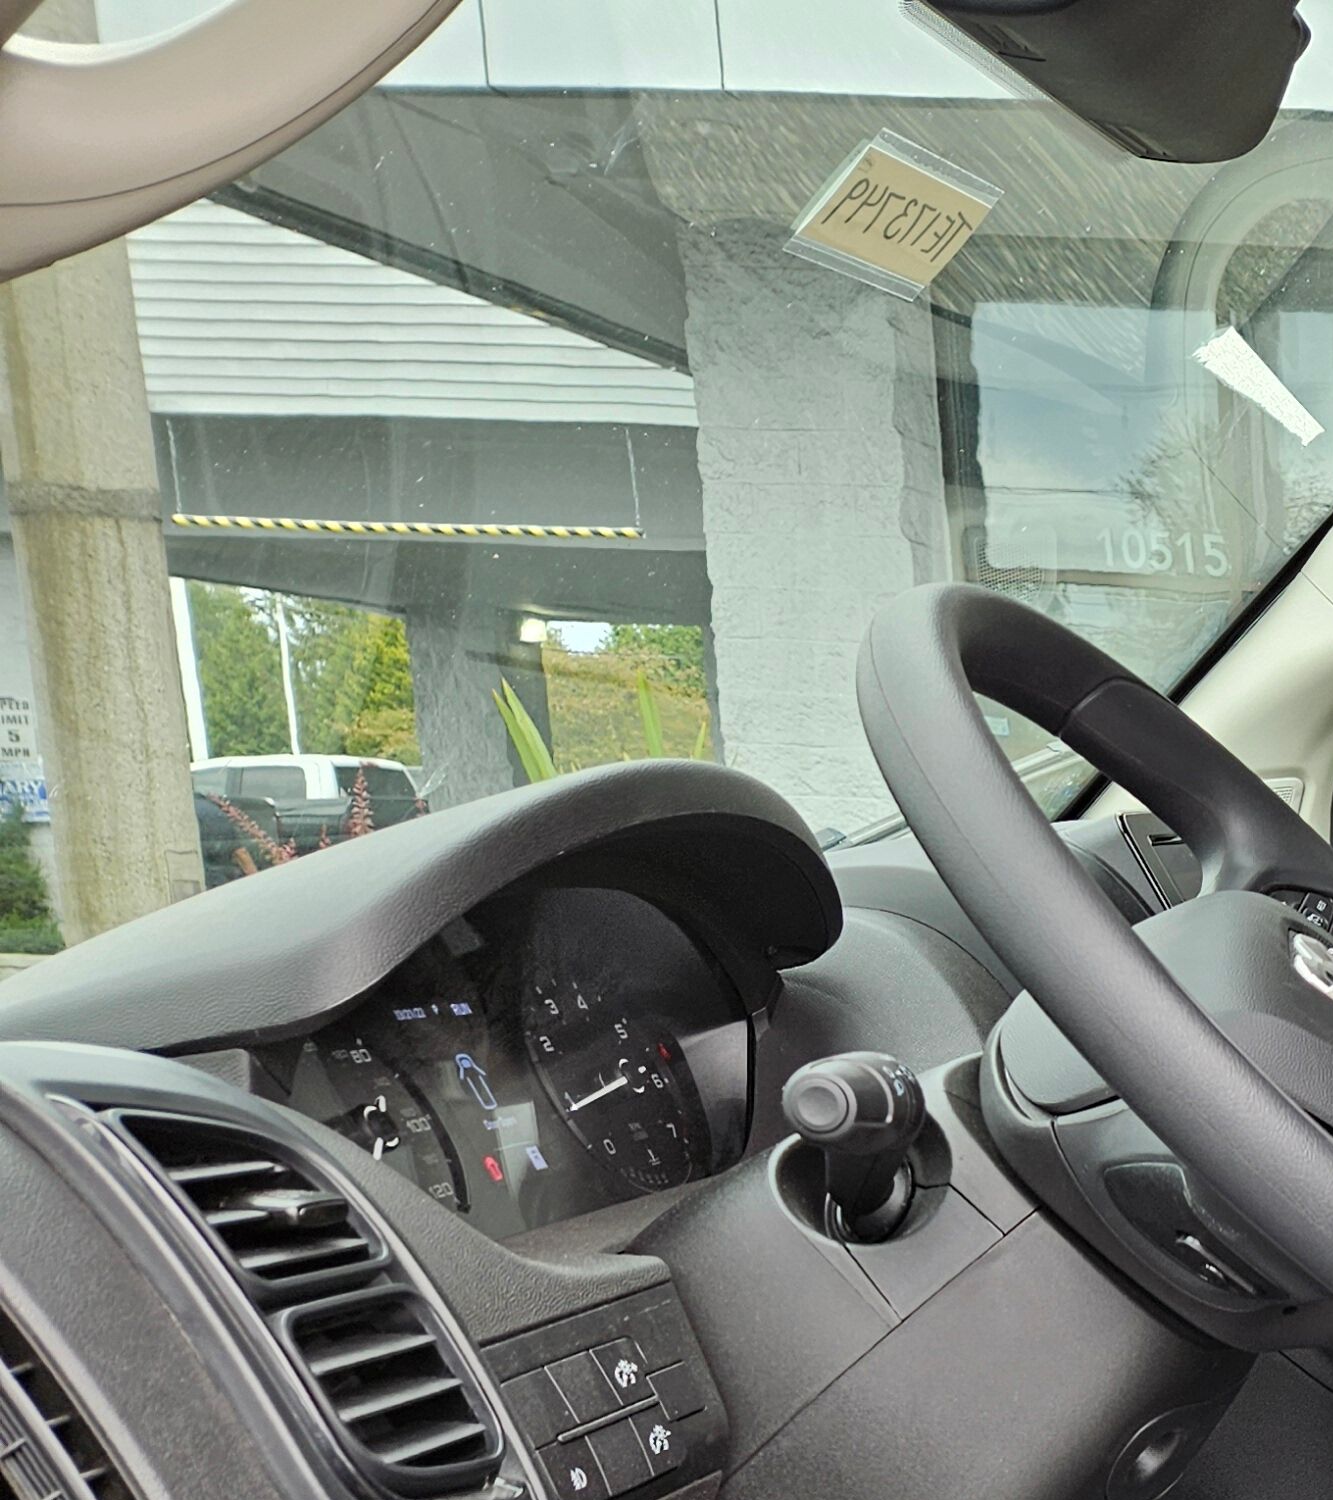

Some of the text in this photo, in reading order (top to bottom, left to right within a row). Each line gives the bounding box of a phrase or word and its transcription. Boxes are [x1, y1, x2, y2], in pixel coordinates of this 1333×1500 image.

[1096, 527, 1229, 577] 10515
[544, 999, 560, 1016] 3
[614, 1023, 629, 1040] 5
[539, 1035, 555, 1053] 2
[350, 1048, 372, 1064] 80
[651, 1073, 664, 1089] 6
[406, 1119, 431, 1133] 100
[602, 1138, 618, 1156] 0
[429, 1182, 455, 1198] 120
